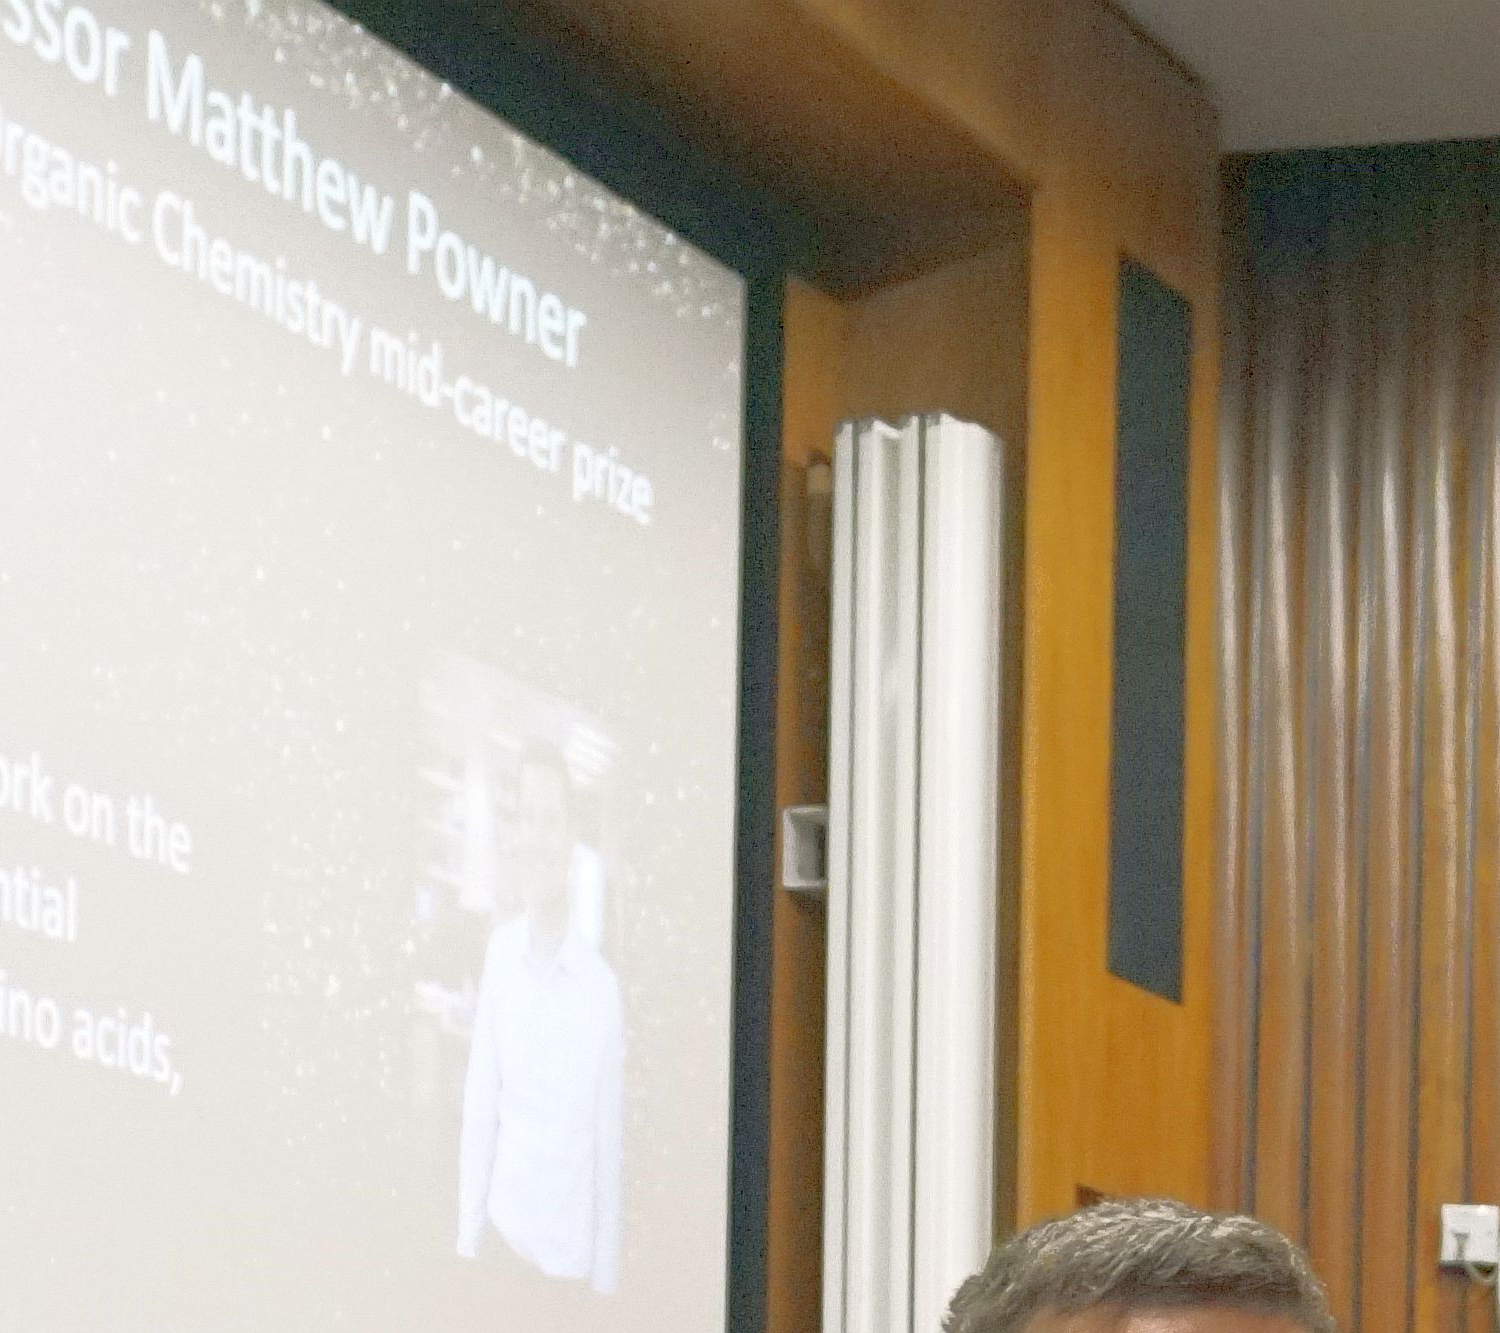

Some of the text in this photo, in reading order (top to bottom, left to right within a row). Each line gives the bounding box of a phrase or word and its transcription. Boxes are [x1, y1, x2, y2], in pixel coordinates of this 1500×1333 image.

[147, 29, 394, 255] Matthew
[406, 189, 588, 368] Powner
[153, 190, 362, 376] Chemistry
[370, 326, 567, 475] mid-career
[572, 440, 654, 526] prize
[62, 783, 117, 846] on
[125, 793, 192, 875] the
[70, 1006, 182, 1096] acids,
